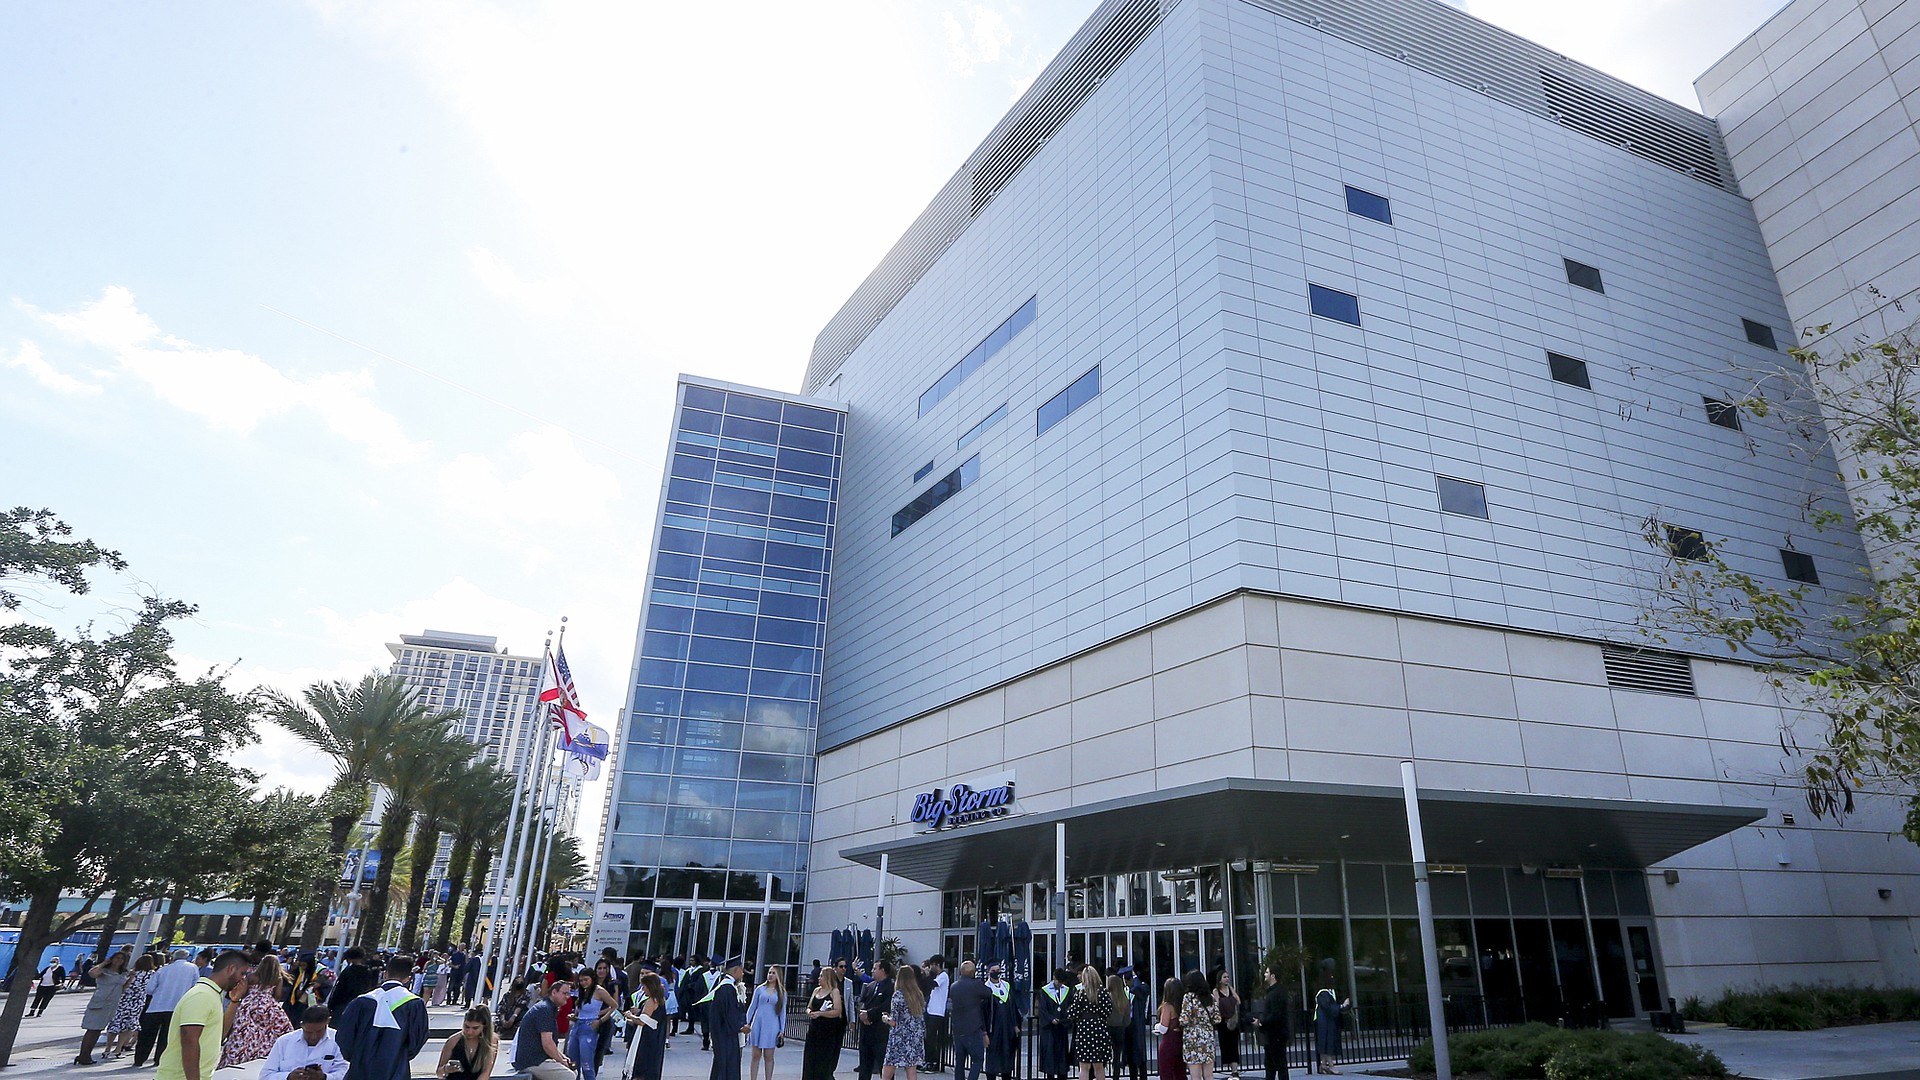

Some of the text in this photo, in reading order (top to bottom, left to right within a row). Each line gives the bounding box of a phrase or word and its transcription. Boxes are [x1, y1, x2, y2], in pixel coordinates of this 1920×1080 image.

[911, 784, 1010, 828] Big Storm
[948, 810, 987, 825] BREWING
[603, 912, 626, 920] Amway
